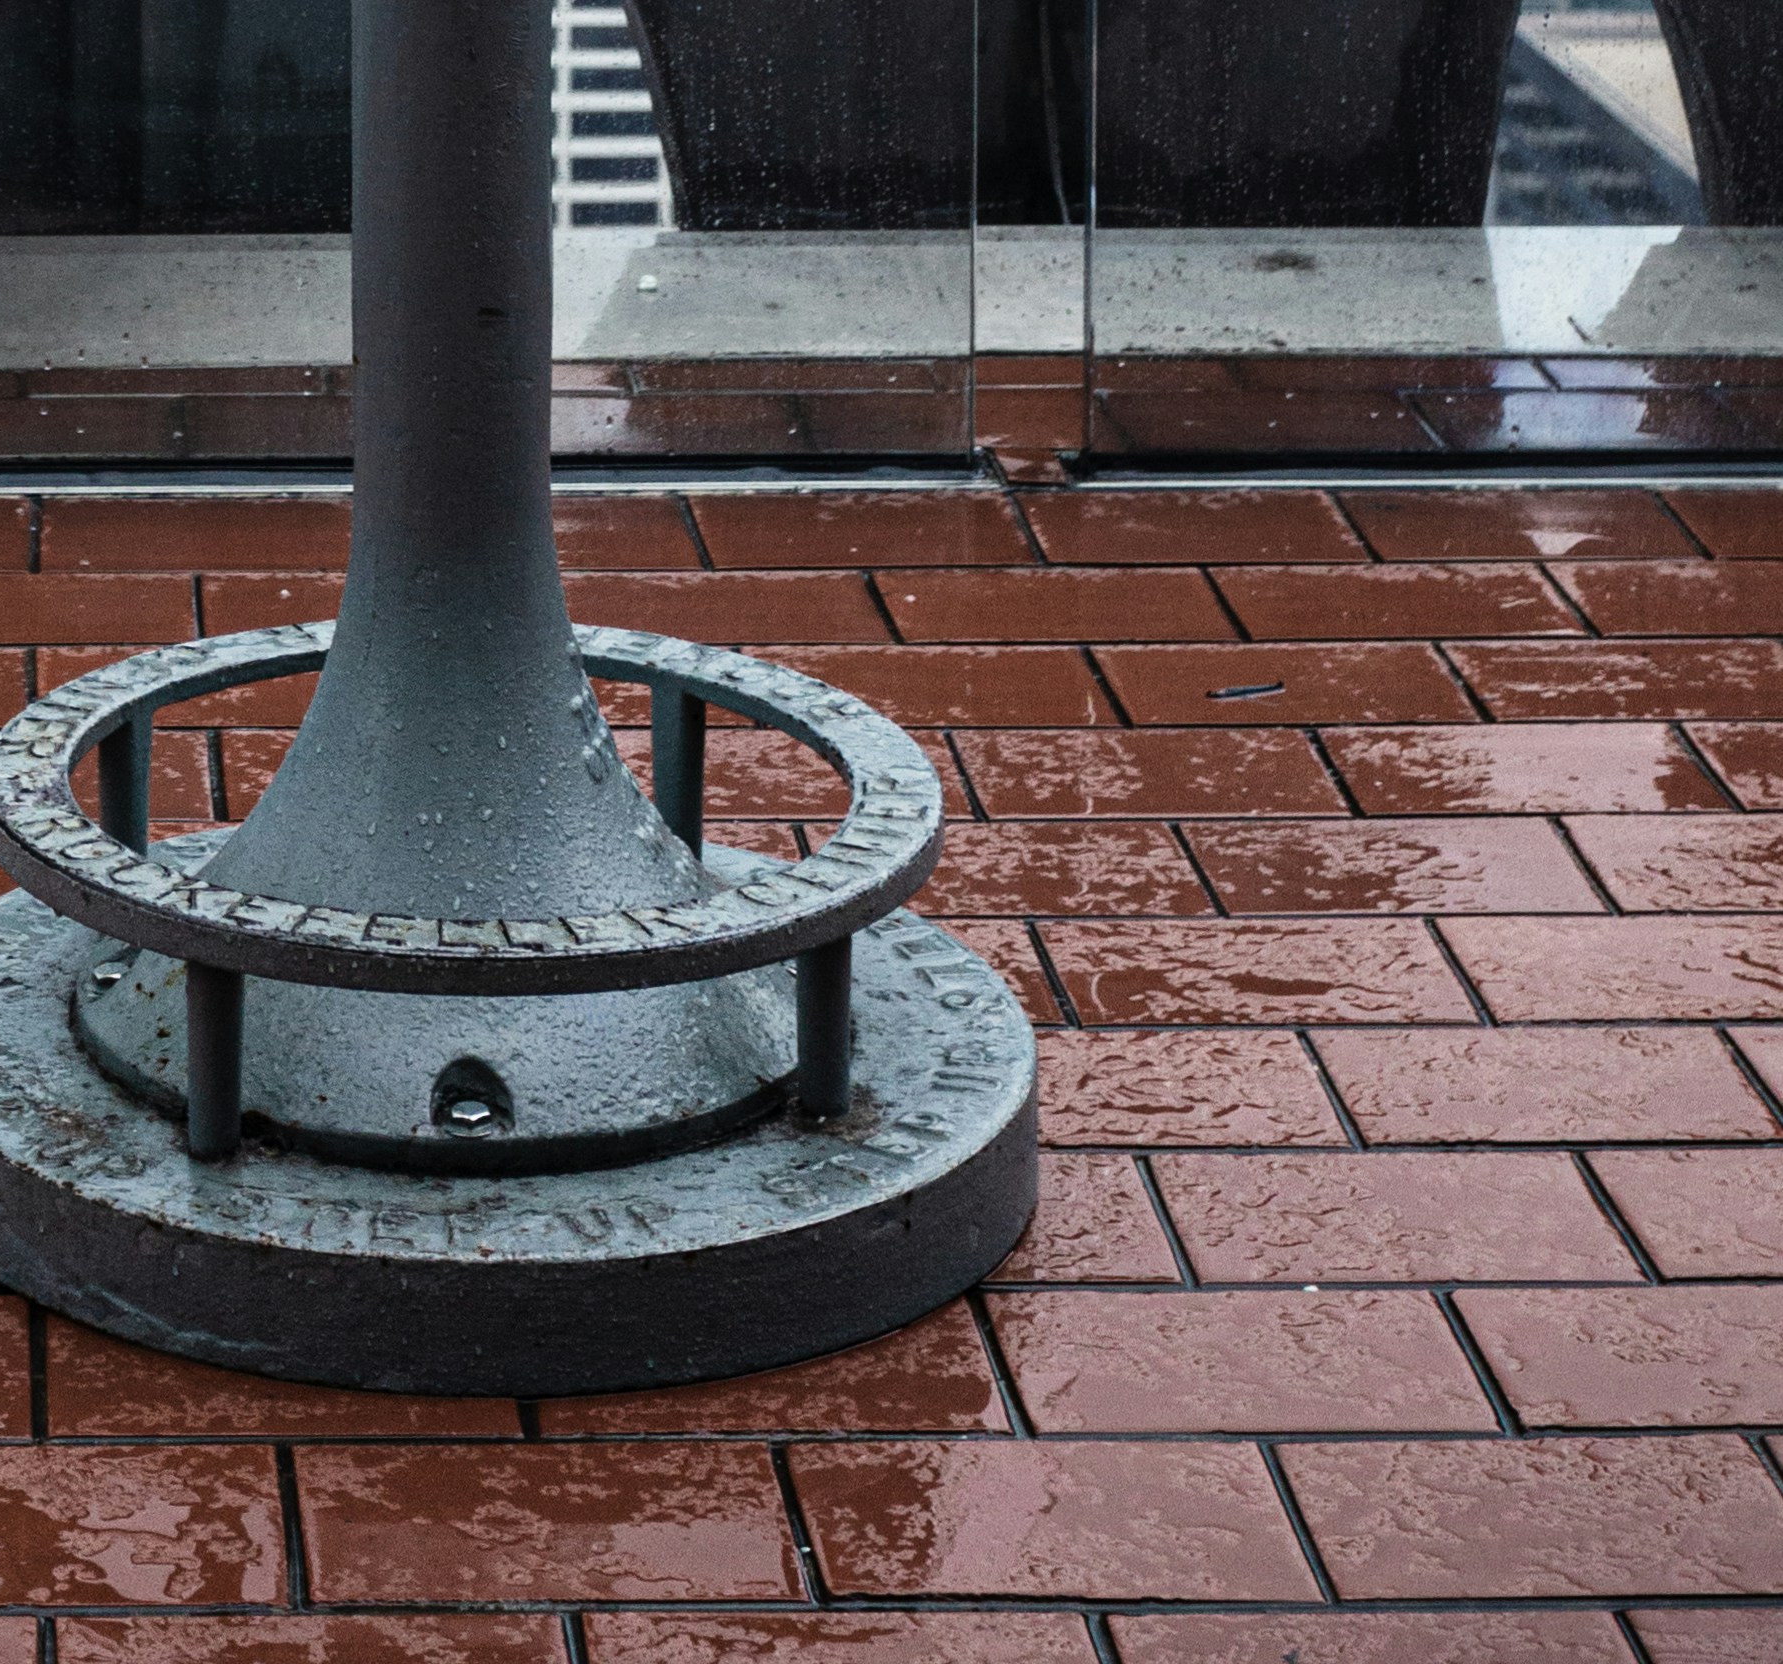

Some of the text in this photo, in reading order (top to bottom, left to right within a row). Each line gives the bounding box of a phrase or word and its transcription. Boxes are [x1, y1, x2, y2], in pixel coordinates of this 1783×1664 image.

[16, 816, 697, 952] ROCKEFELLER
[761, 1109, 954, 1209] STEP
[213, 1186, 673, 1247] STEP UP
